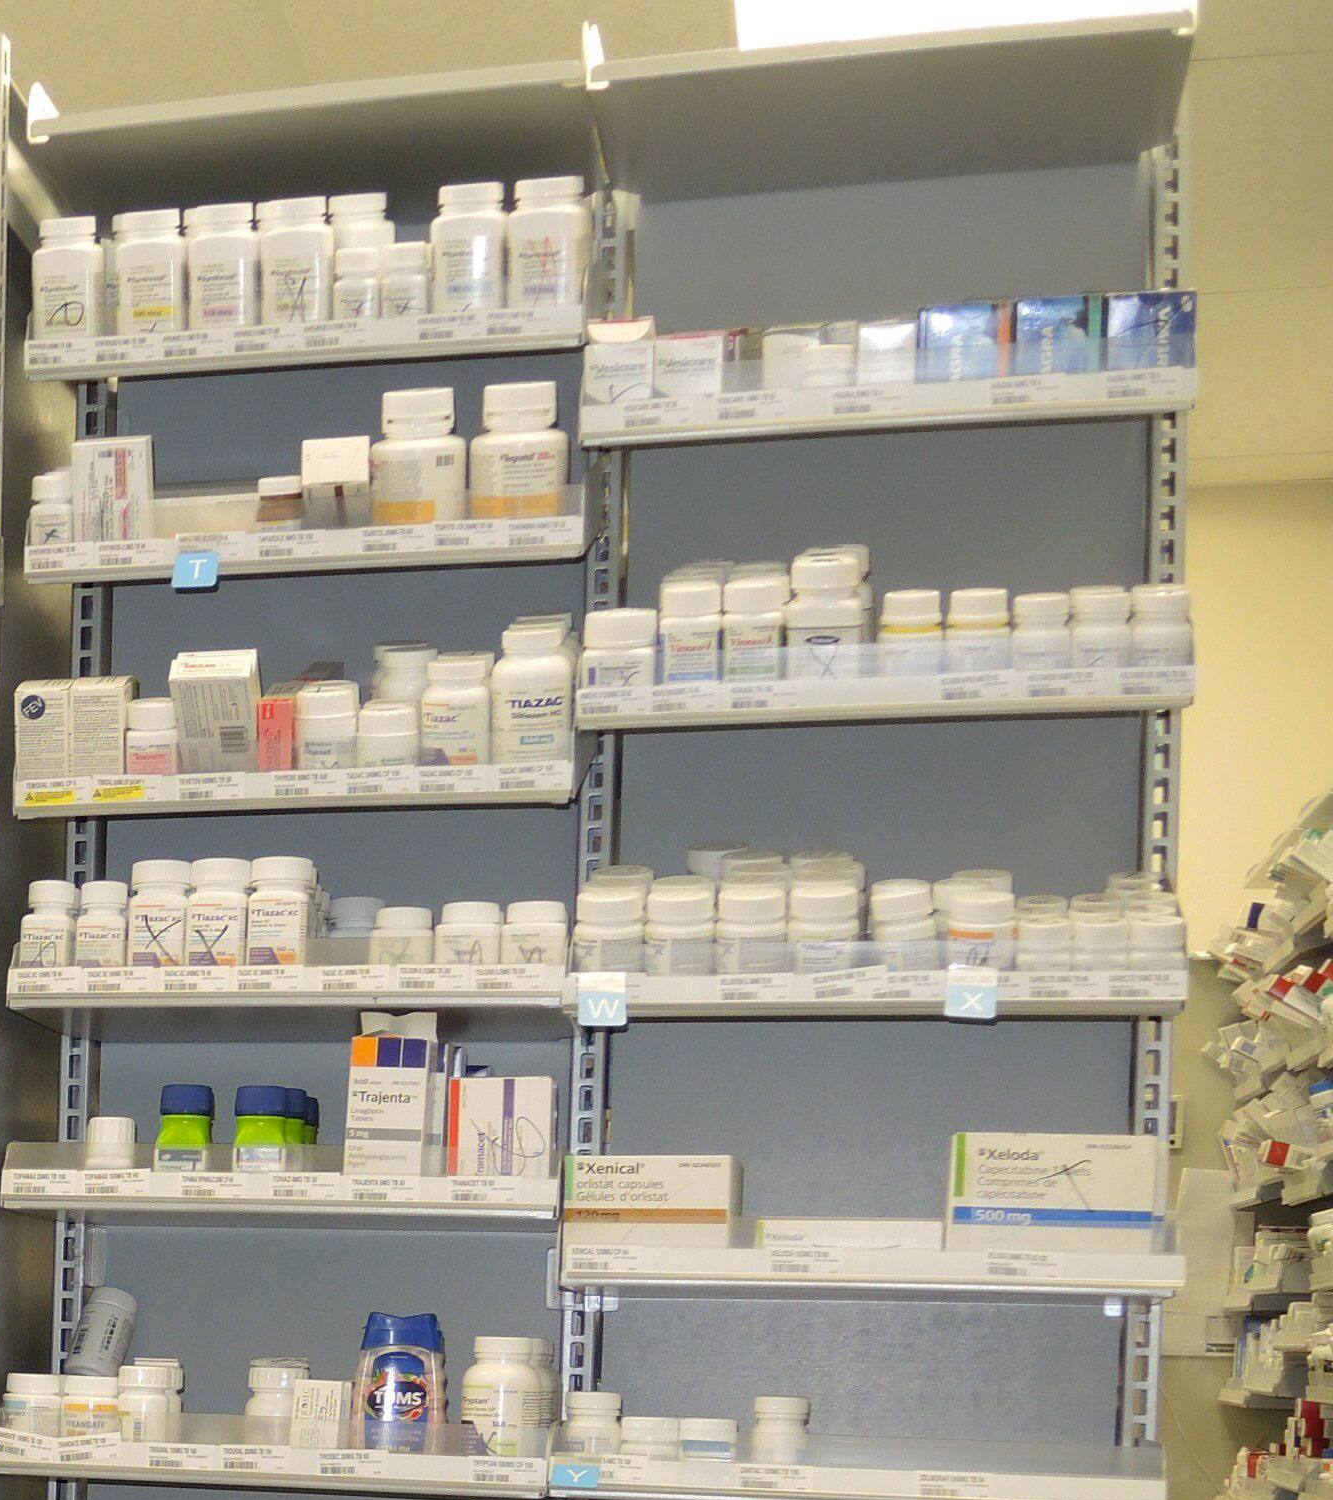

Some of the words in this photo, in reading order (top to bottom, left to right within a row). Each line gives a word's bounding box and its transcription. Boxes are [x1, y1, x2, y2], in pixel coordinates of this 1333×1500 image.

[188, 558, 208, 580] T
[509, 696, 564, 709] TIAZAC
[960, 991, 983, 1010] X
[588, 999, 620, 1018] W
[359, 1090, 411, 1105] Trajenta
[986, 1149, 1039, 1161] Xeloda
[585, 1161, 640, 1175] Xenical
[976, 1209, 1005, 1222] 500
[1006, 1212, 1032, 1226] mg
[565, 1469, 588, 1483] Y
